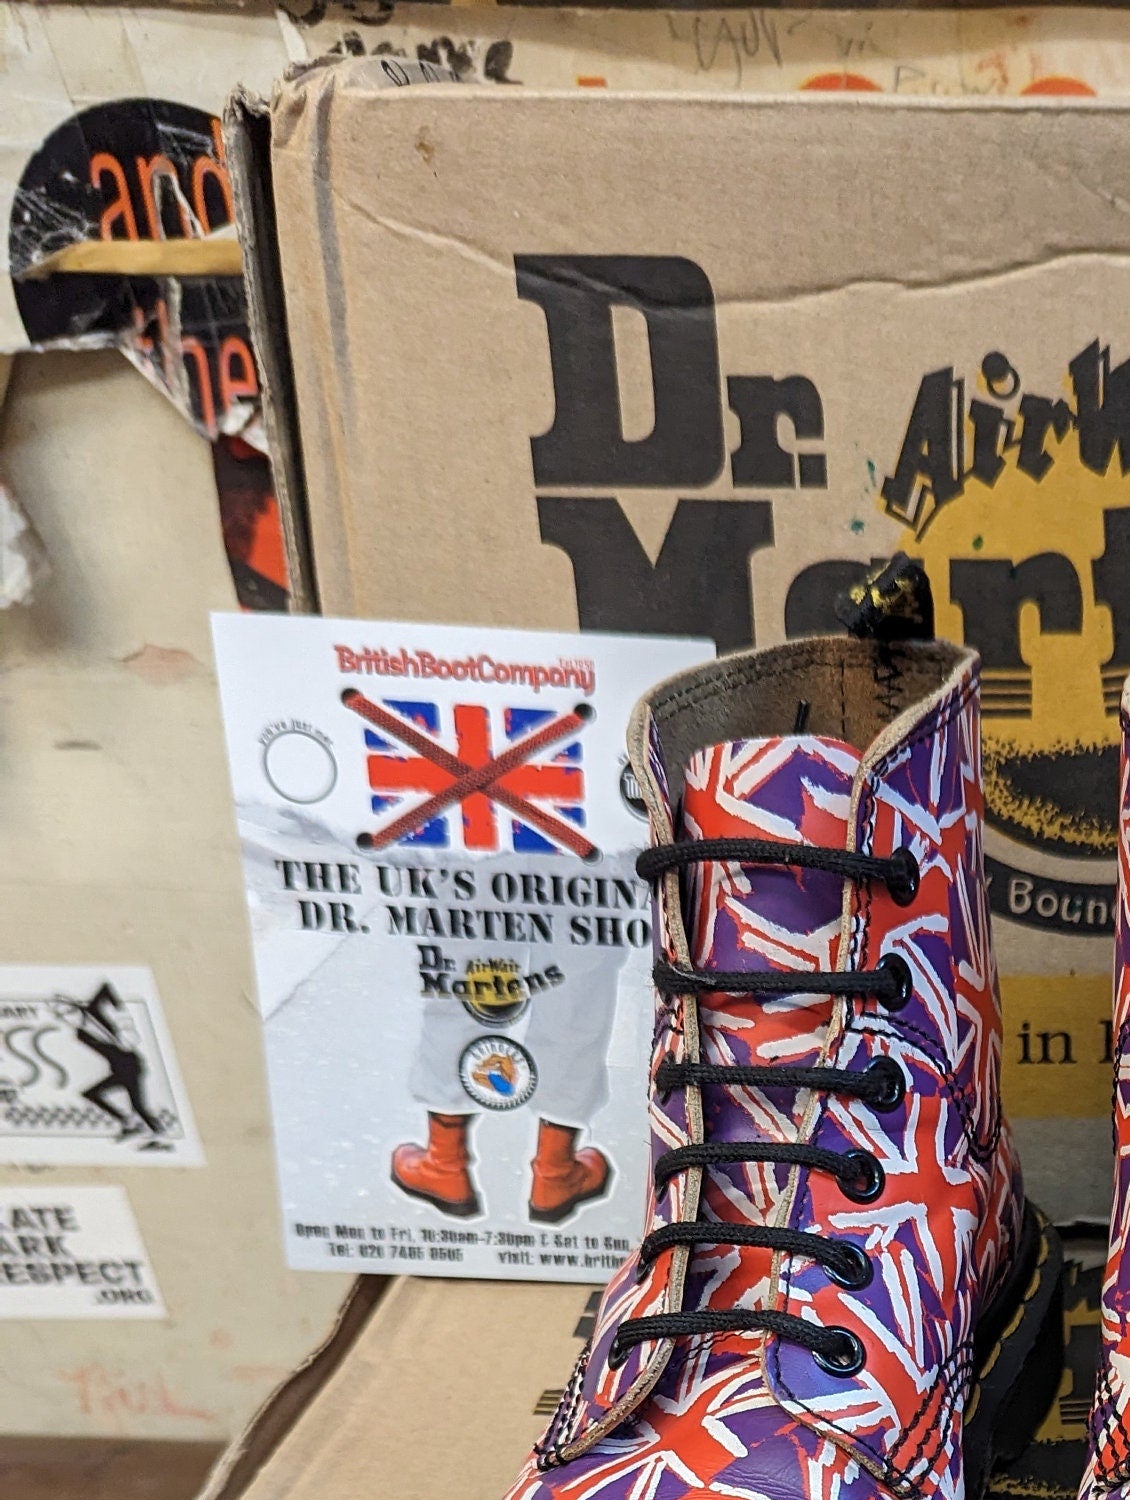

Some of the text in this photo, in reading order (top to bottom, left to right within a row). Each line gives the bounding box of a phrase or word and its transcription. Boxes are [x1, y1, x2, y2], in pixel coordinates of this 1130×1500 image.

[276, 859, 363, 895] THE
[378, 865, 477, 902] UK'S
[299, 900, 371, 934] DR.
[386, 904, 554, 944] MARTEN
[419, 964, 566, 999] Martens
[1016, 1021, 1077, 1065] in
[0, 1206, 80, 1232] ATE
[335, 1224, 366, 1239] Mon
[371, 1228, 385, 1240] to
[554, 1233, 579, 1249] Sat
[585, 1236, 599, 1249] to
[0, 1262, 143, 1285] ESPECT
